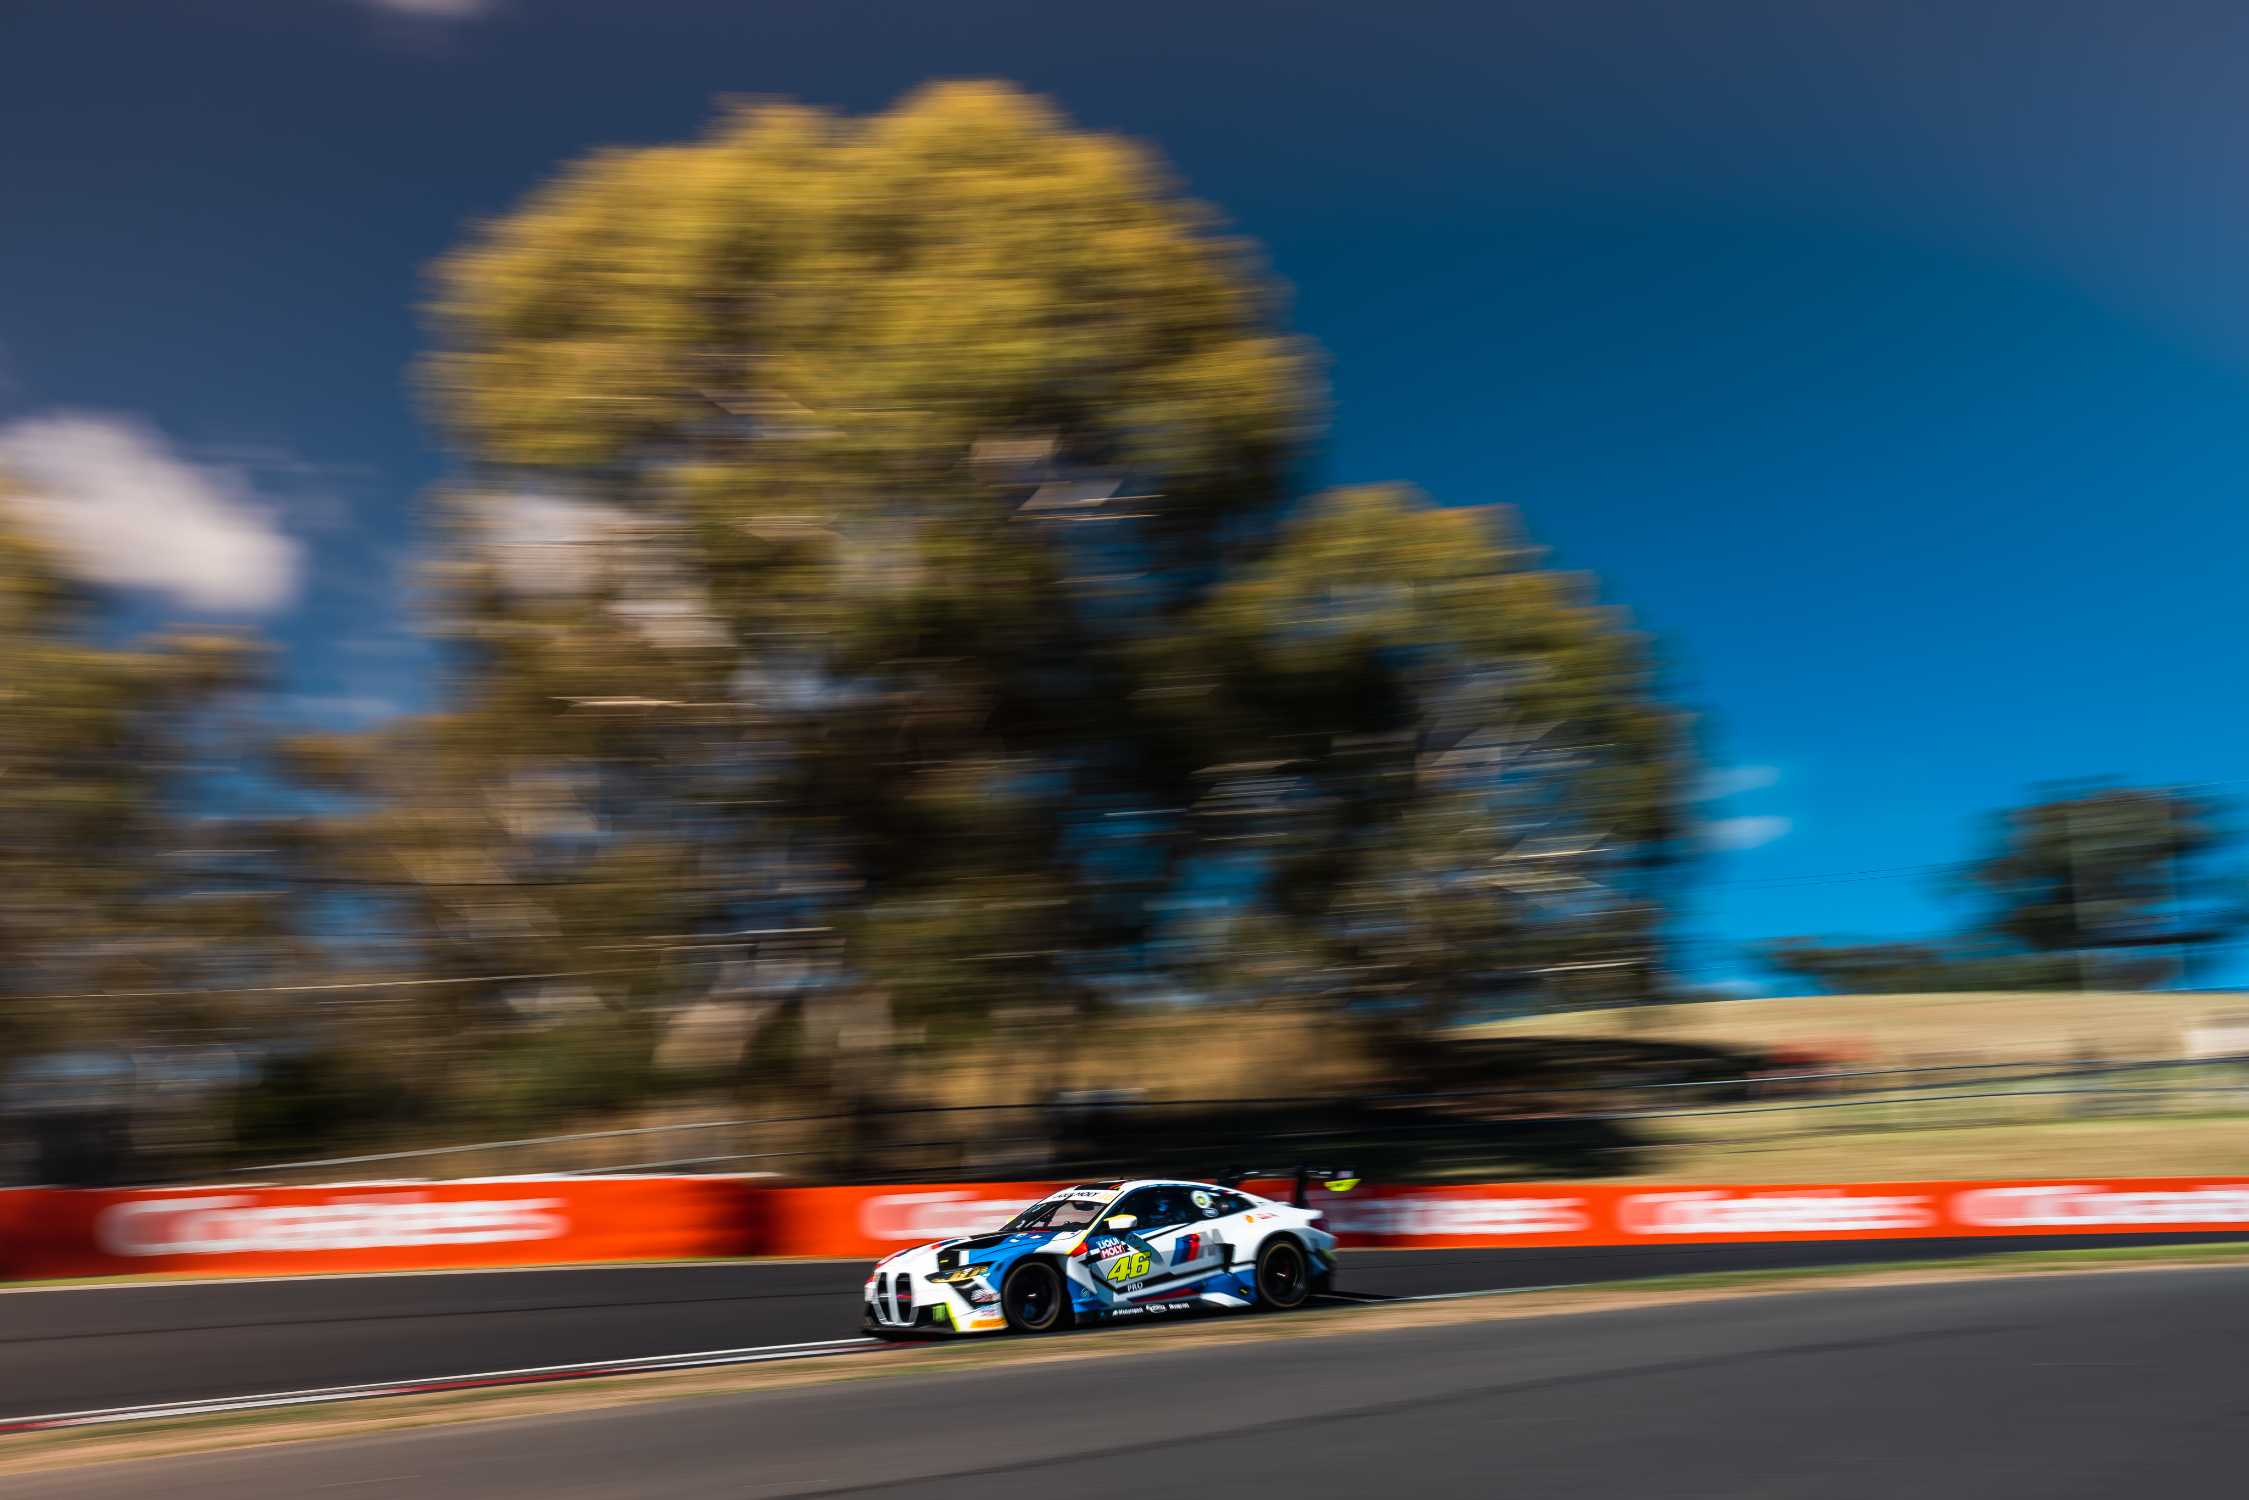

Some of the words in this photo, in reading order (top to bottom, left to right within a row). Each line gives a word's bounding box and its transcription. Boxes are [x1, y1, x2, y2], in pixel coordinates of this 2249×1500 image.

[1095, 1237, 1120, 1250] LIQUI
[1100, 1244, 1124, 1259] MOLY
[1107, 1251, 1151, 1282] 46
